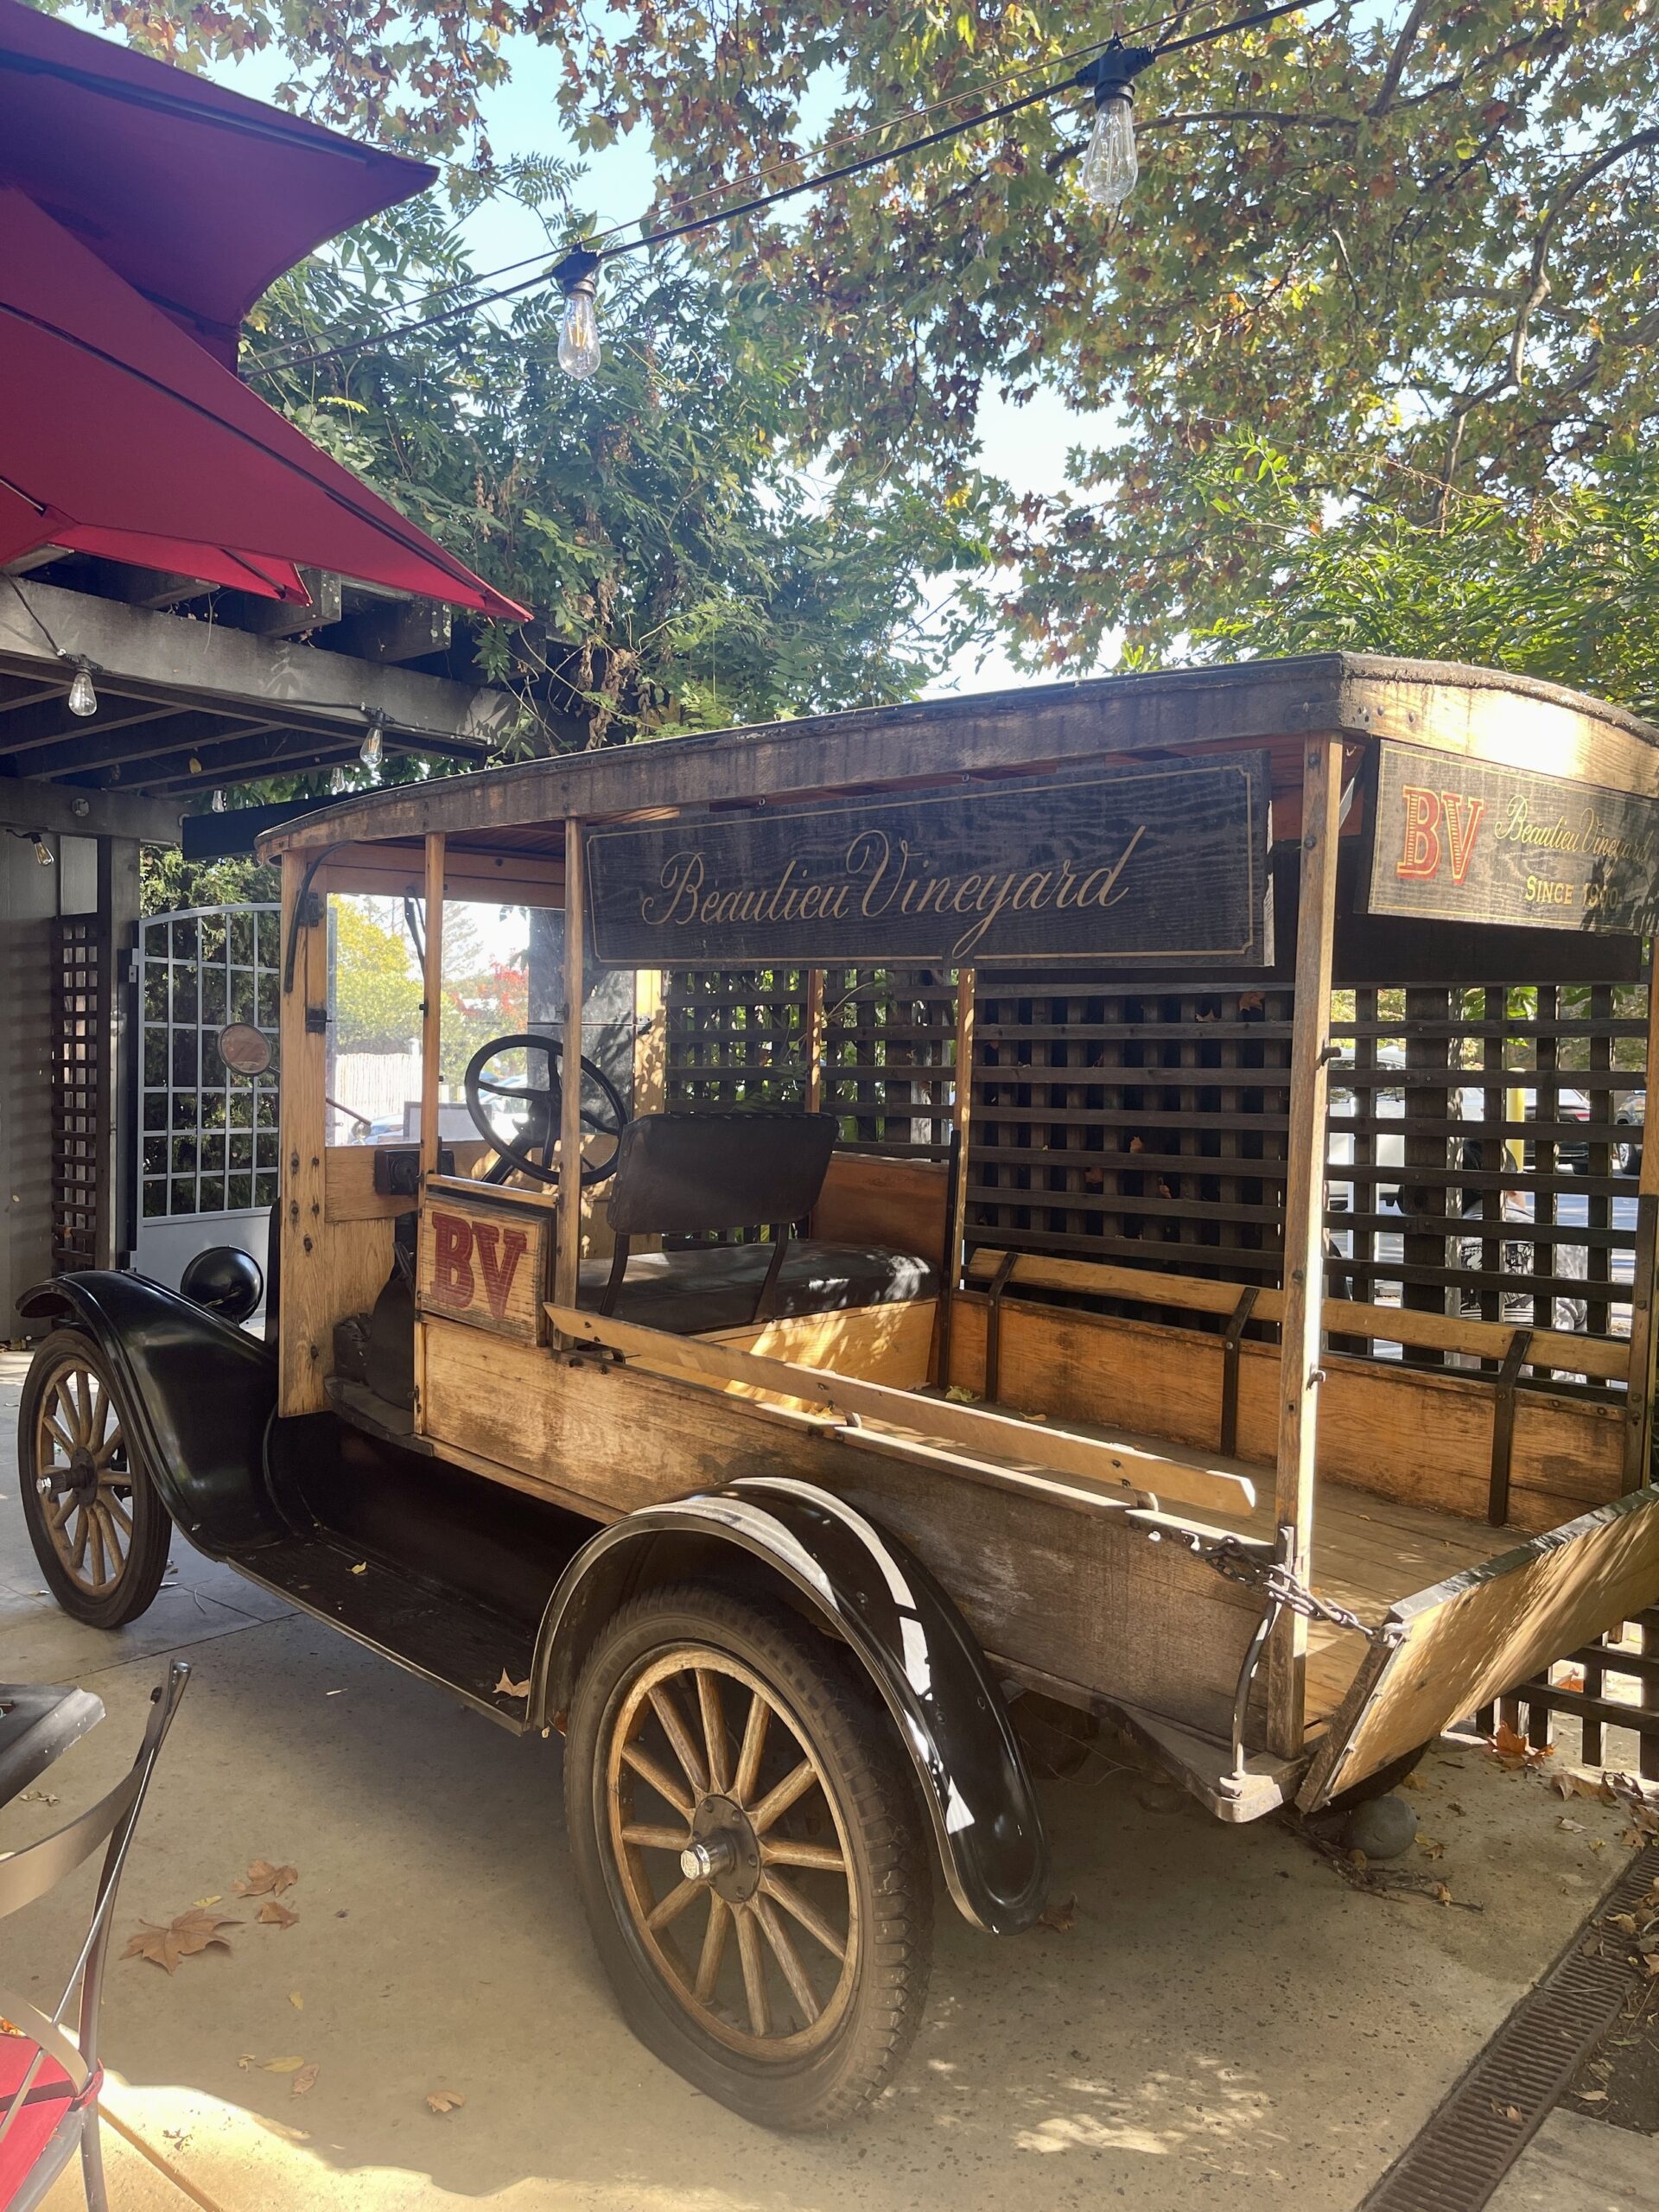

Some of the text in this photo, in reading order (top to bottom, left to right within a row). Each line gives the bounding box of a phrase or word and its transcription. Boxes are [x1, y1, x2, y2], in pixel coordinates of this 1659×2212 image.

[1395, 785, 1486, 886] BV
[1494, 794, 1655, 879] Beaulieu Vineyard
[641, 824, 1146, 960] Beaulieu Vineyard
[1524, 874, 1618, 910] SINCE 1900
[429, 1211, 528, 1320] BV
